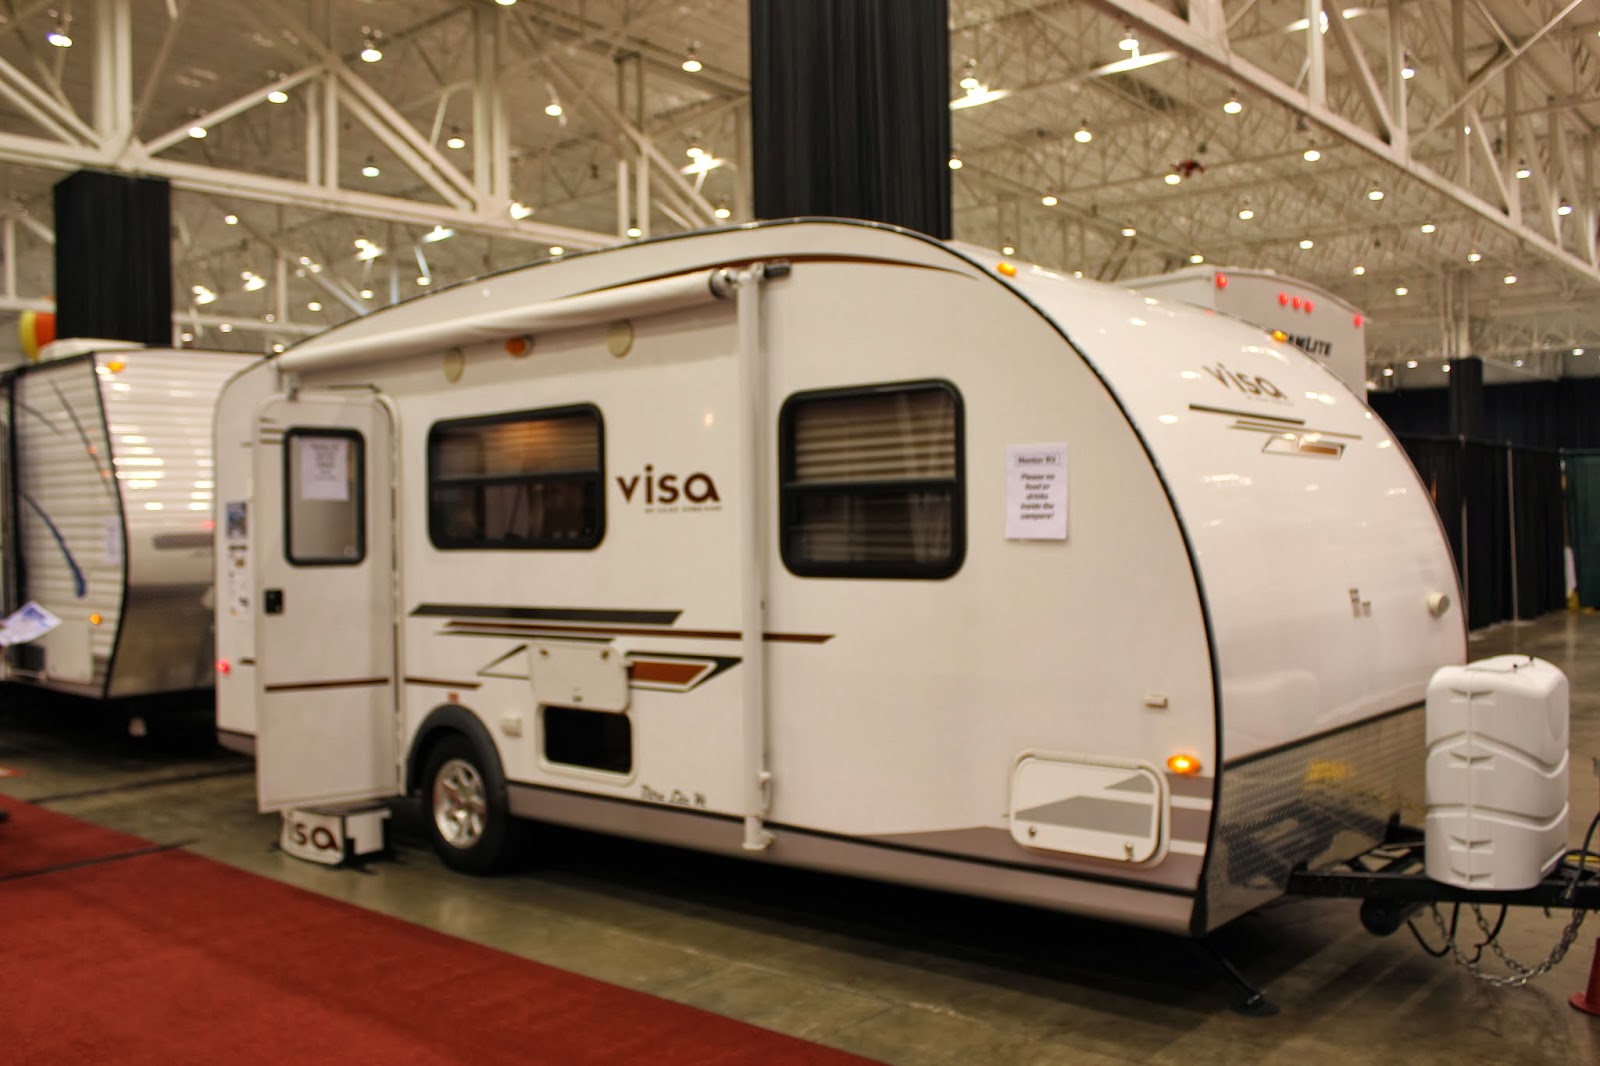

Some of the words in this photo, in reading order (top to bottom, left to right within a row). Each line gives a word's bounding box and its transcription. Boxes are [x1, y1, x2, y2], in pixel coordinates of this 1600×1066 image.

[1202, 362, 1288, 399] visa
[615, 463, 721, 505] visa
[1021, 473, 1044, 481] Please
